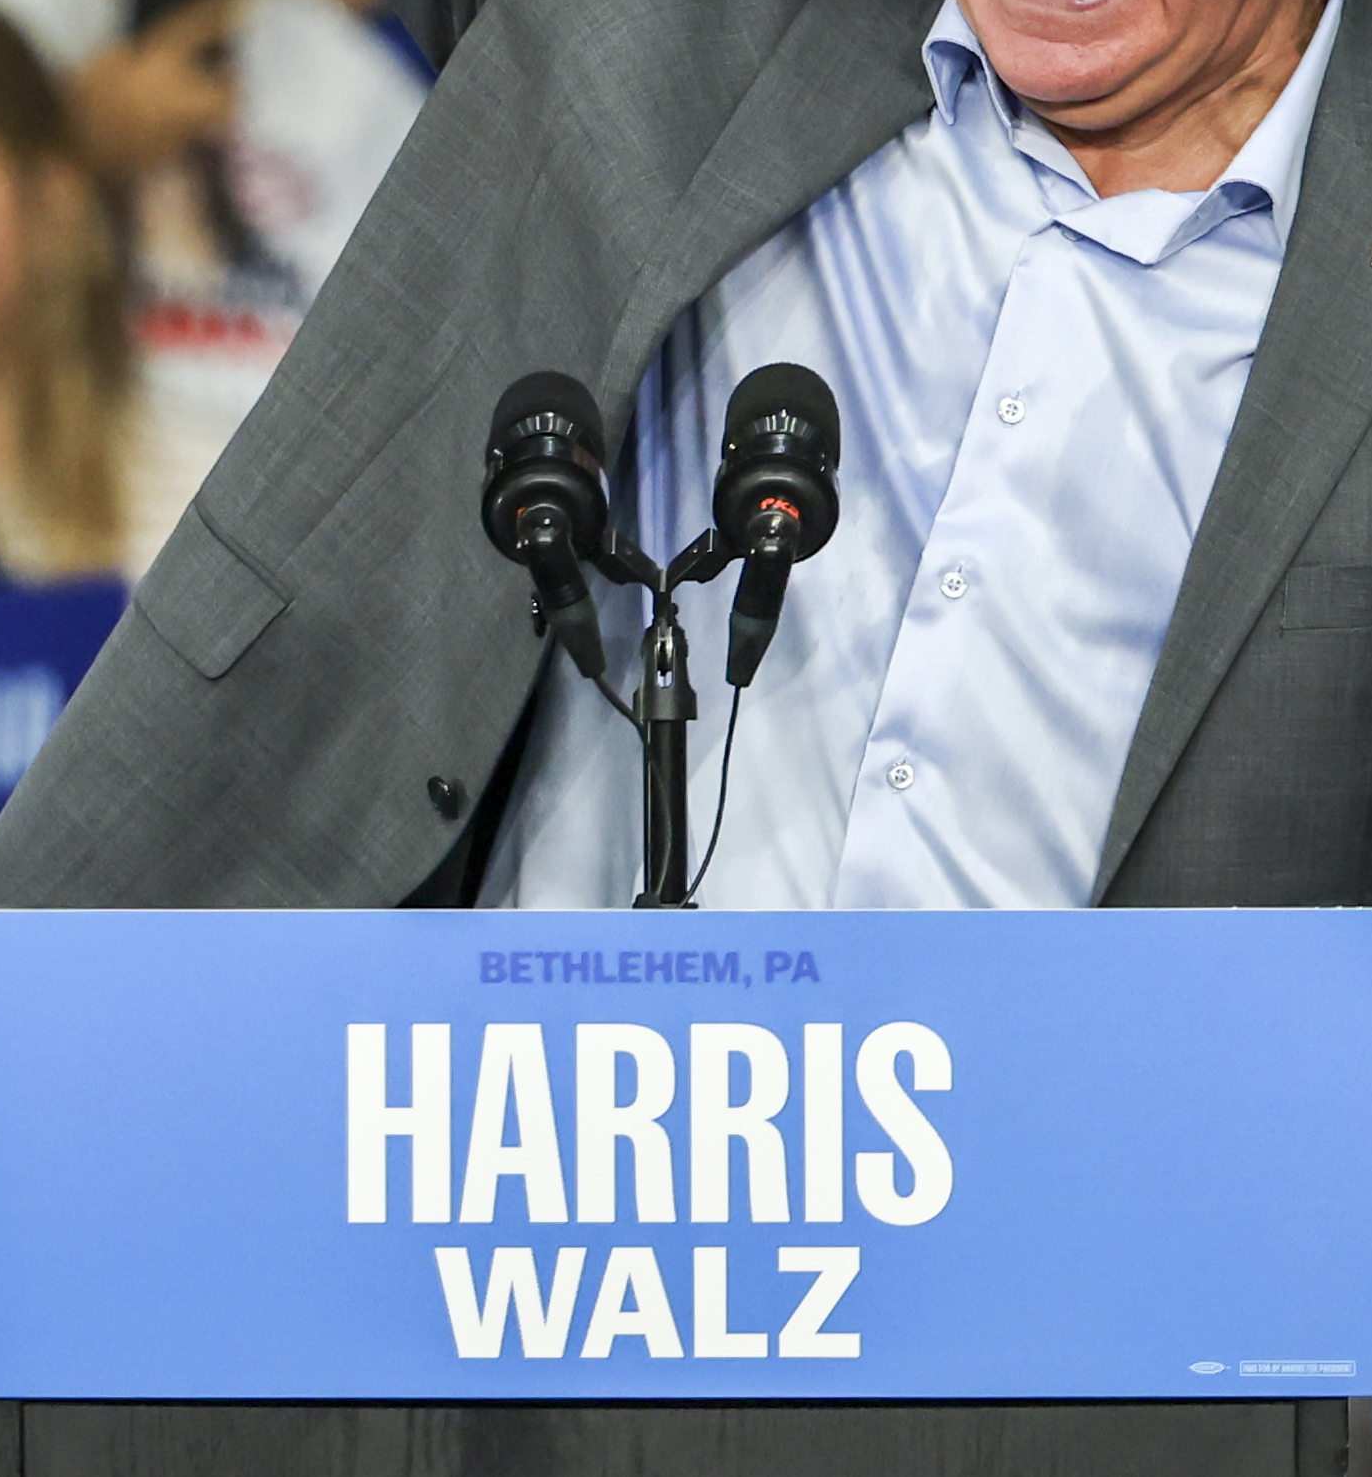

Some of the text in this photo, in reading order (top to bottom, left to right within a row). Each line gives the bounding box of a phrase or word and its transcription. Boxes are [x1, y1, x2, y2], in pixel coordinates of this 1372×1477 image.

[482, 951, 820, 988] BETHLEHEM, PA
[347, 1021, 953, 1226] HARRIS
[434, 1246, 861, 1360] WALZ
